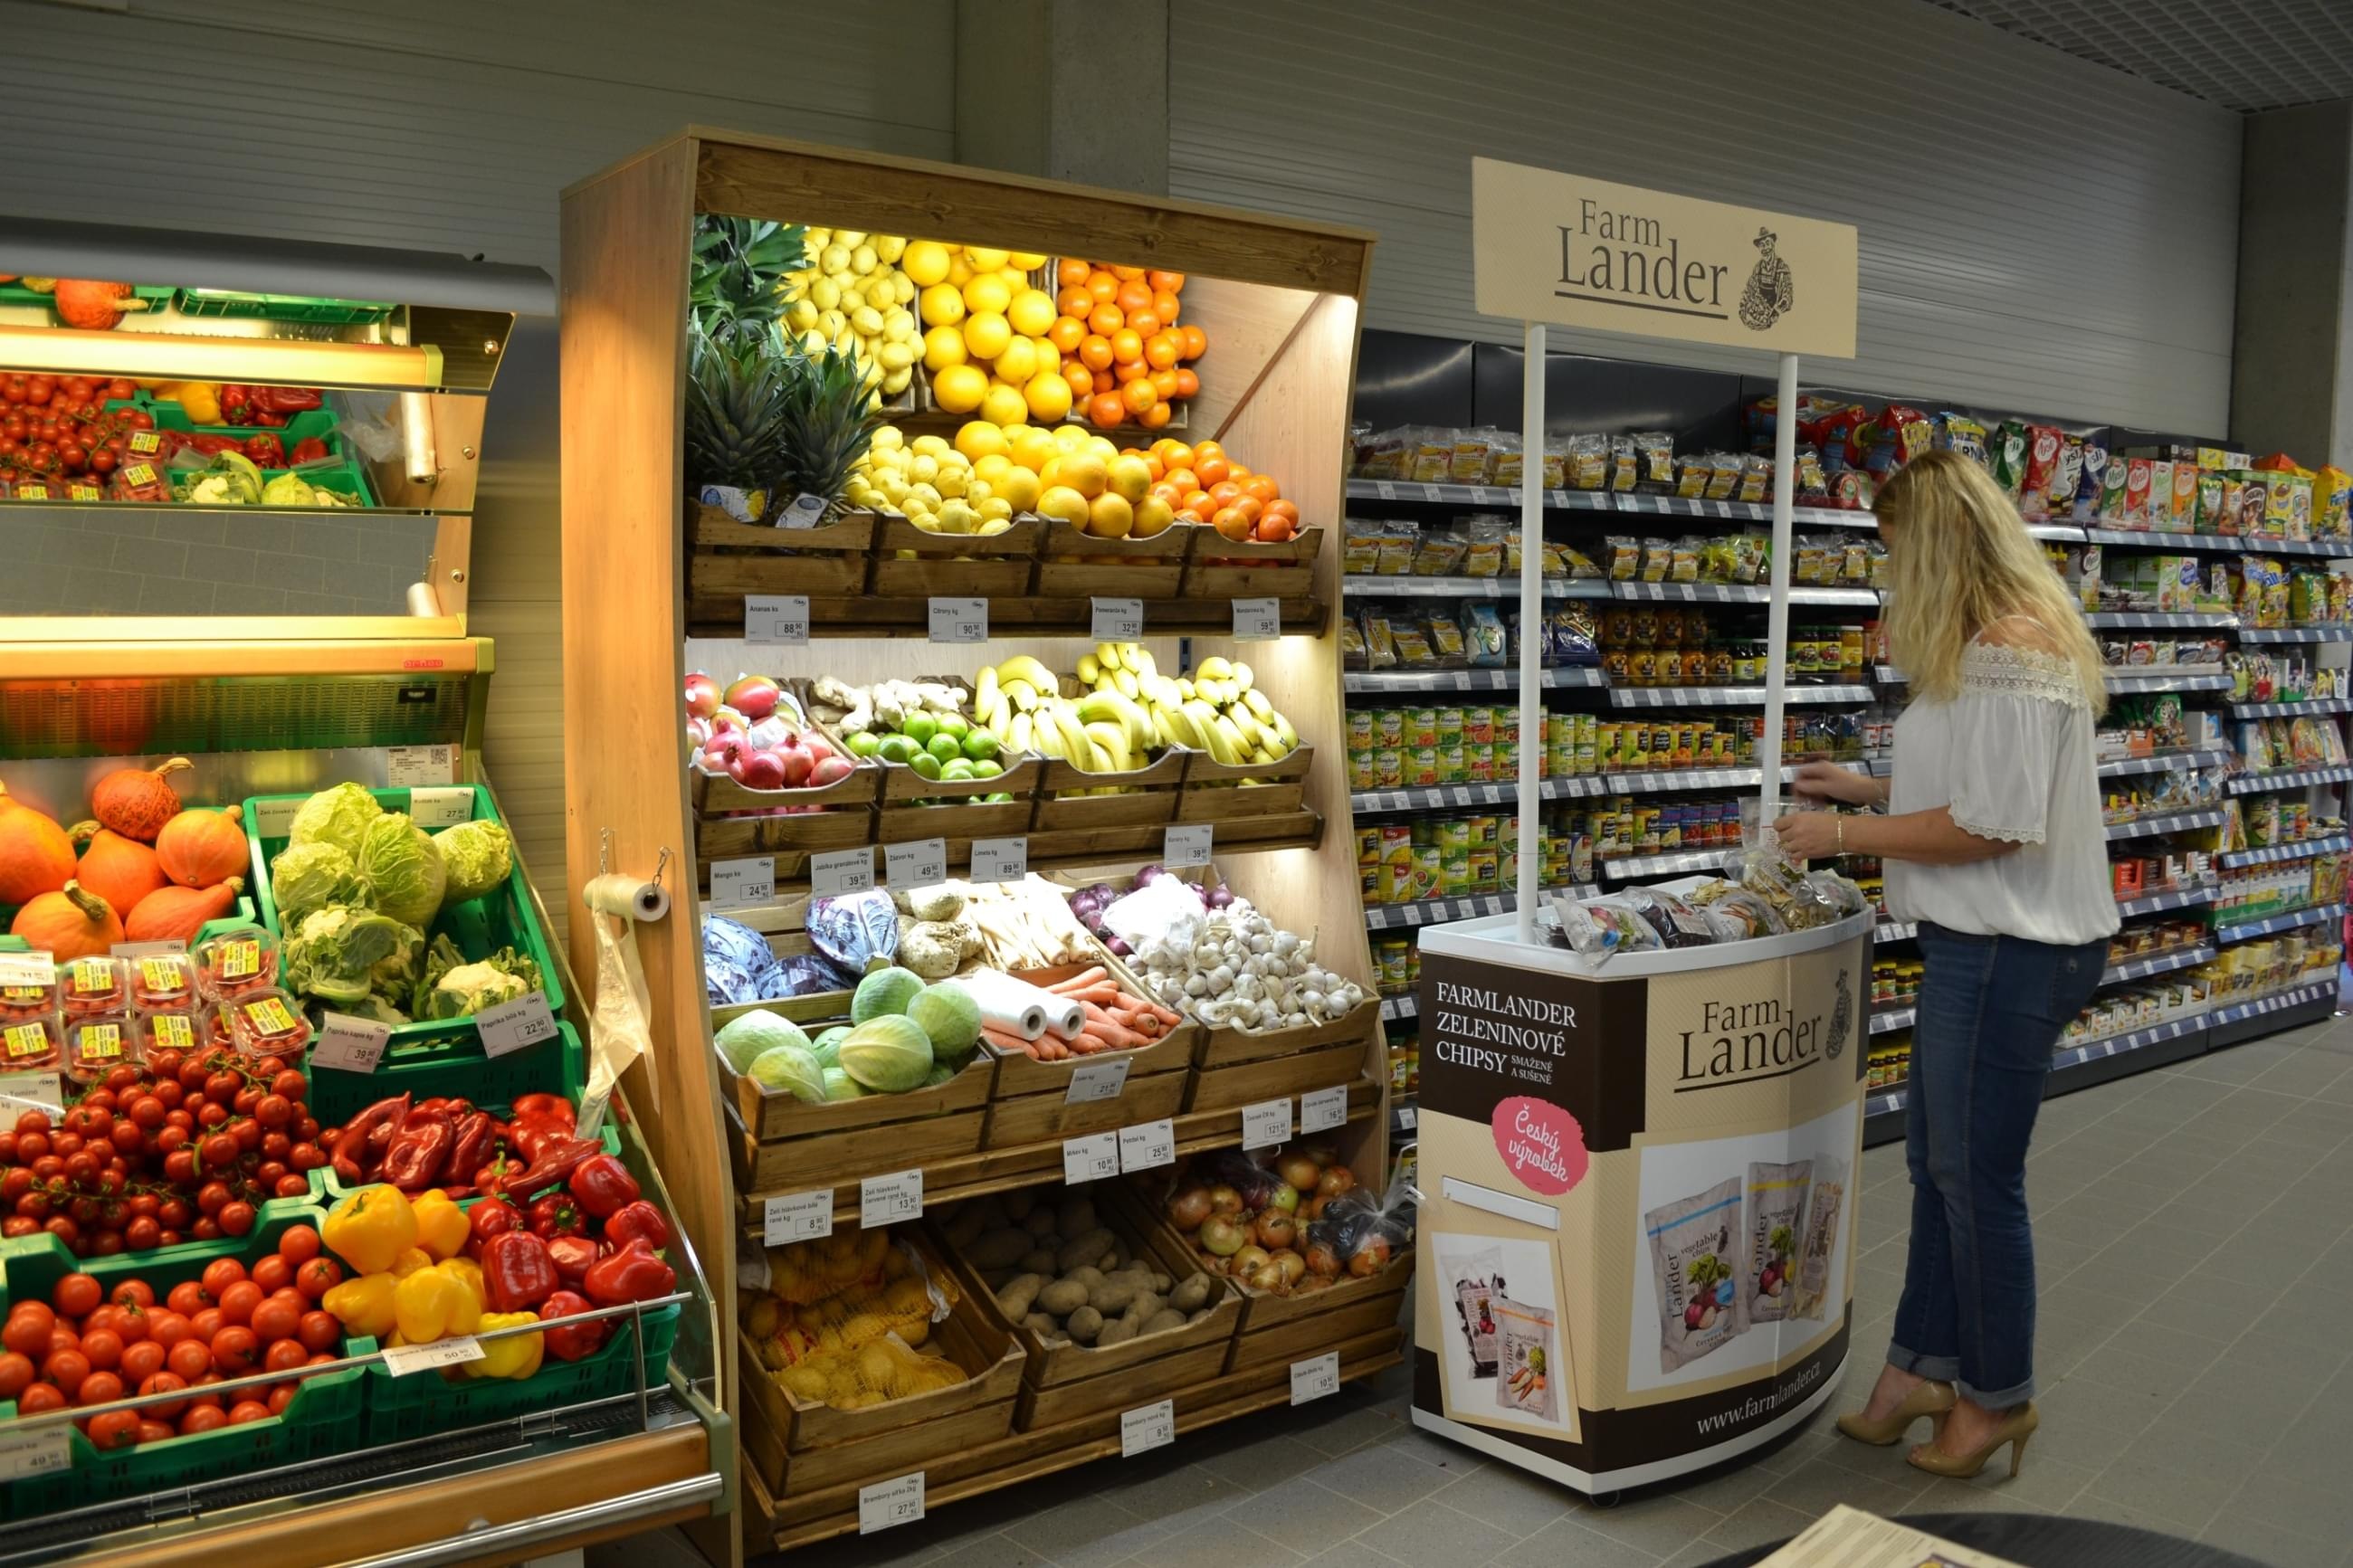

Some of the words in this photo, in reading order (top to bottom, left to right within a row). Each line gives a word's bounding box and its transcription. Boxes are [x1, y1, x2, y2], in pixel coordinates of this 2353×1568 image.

[1579, 198, 1662, 248] Farm
[1557, 225, 1728, 306] Lander
[784, 623, 795, 634] 88
[963, 624, 973, 634] 90
[1122, 623, 1131, 632] 32
[447, 810, 456, 818] 27
[1193, 850, 1201, 859] 39
[921, 866, 931, 876] 49
[1003, 864, 1012, 874] 89
[714, 871, 733, 880] Mango
[849, 876, 858, 886] 39
[749, 886, 759, 897] 24
[1436, 982, 1577, 1028] FARMLANDER
[1701, 999, 1782, 1034] Farm
[481, 1017, 505, 1030] Paprika
[525, 1023, 538, 1035] 22
[327, 1026, 348, 1036] Paprika
[1436, 1012, 1567, 1057] ZELENINOVÉ
[1678, 1010, 1822, 1081] Lander
[354, 1049, 367, 1060] 39
[1436, 1041, 1508, 1074] CHIPSY
[1510, 1054, 1554, 1072] SMAŽENÉ
[1510, 1067, 1519, 1078] A
[1519, 1069, 1553, 1085] SUŠENÉ
[1268, 1124, 1280, 1135] 121
[1515, 1103, 1561, 1162] Český
[1066, 1149, 1081, 1157] Mrkev
[1152, 1148, 1162, 1158] 25
[1097, 1161, 1107, 1171] 10
[1508, 1139, 1568, 1182] výrobek
[899, 1199, 909, 1210] 13
[769, 1208, 779, 1216] Zelí
[783, 1214, 790, 1222] kg
[809, 1219, 815, 1230] 8
[1681, 1232, 1719, 1255] vegetable
[1667, 1254, 1683, 1318] Lander
[1319, 1378, 1328, 1388] 10
[1697, 1361, 1821, 1434] www.farmlander.cz
[1157, 1428, 1162, 1437] 9
[897, 1504, 908, 1515] 27
